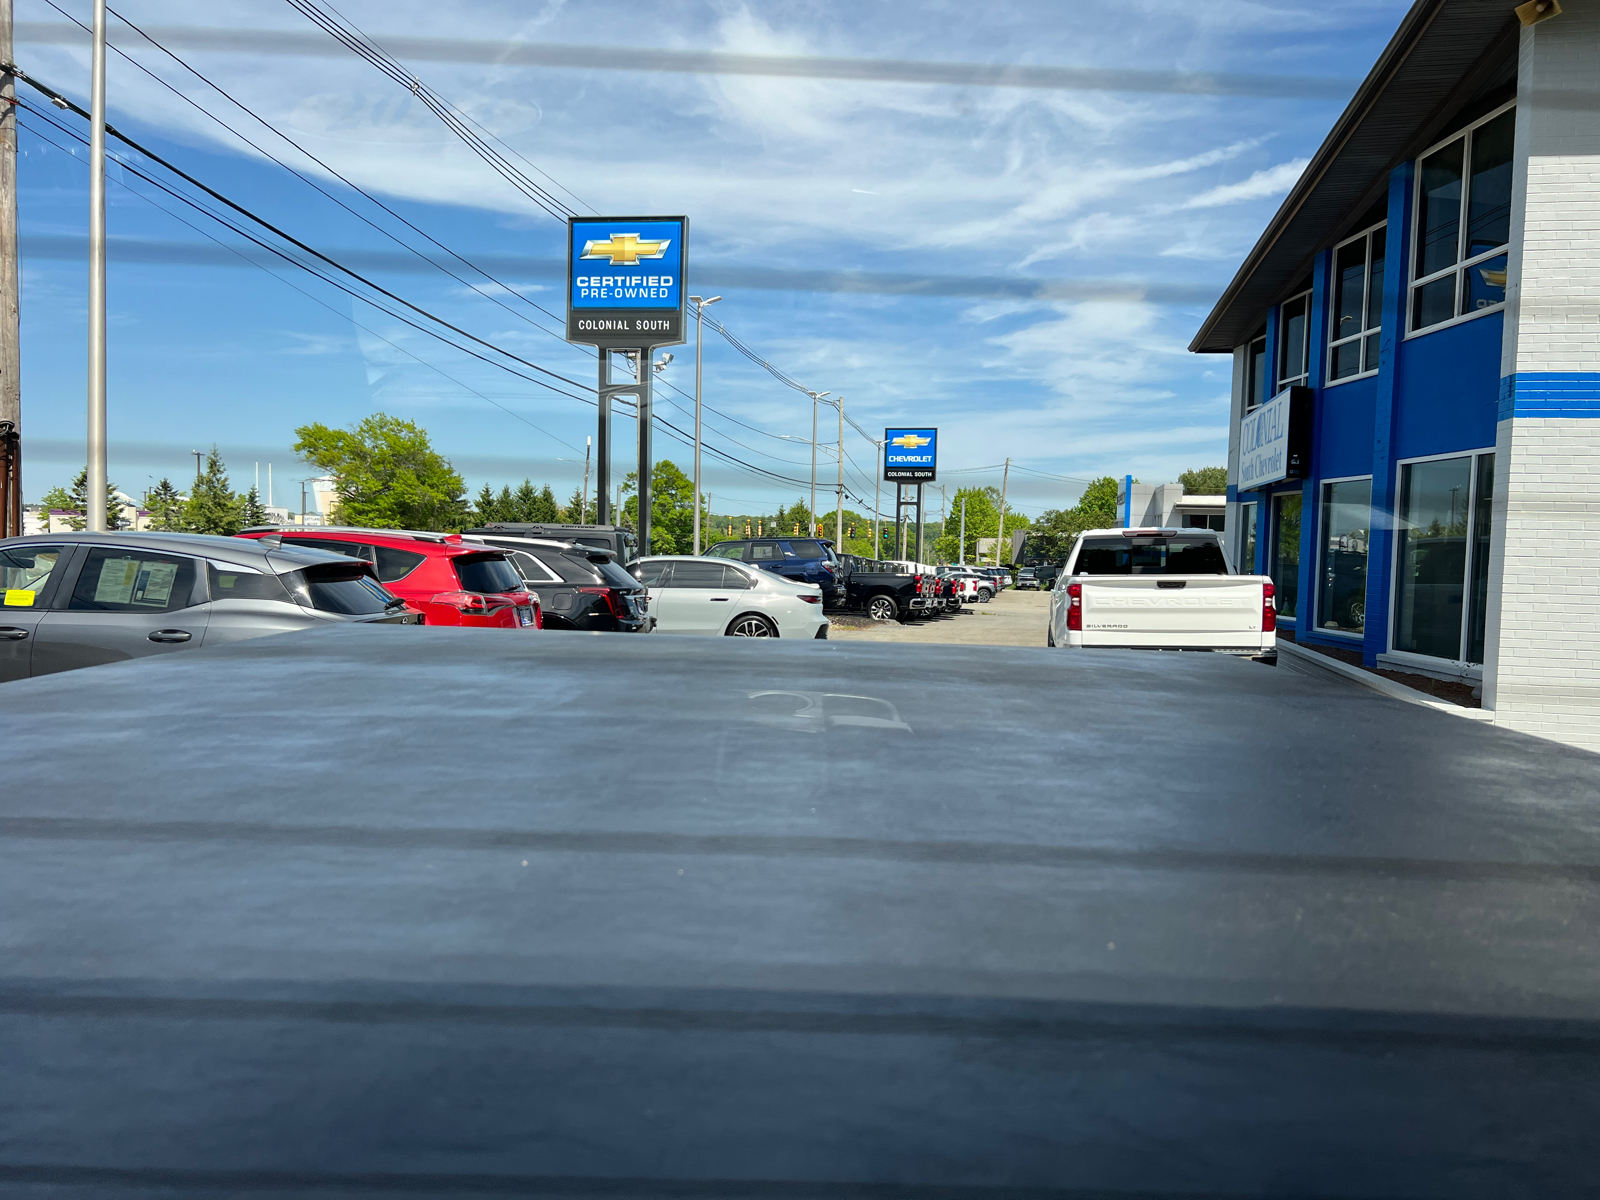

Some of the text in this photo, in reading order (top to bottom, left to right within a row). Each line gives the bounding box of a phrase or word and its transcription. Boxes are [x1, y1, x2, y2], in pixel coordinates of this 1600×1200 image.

[576, 276, 673, 287] CERTIFIED
[581, 288, 668, 298] PRE-OWNED
[578, 320, 670, 330] COLONIAL SOUTH
[1242, 402, 1283, 456] COLONIAL
[1241, 447, 1282, 484] South Chevrolet
[1094, 597, 1250, 607] CHEVROLET
